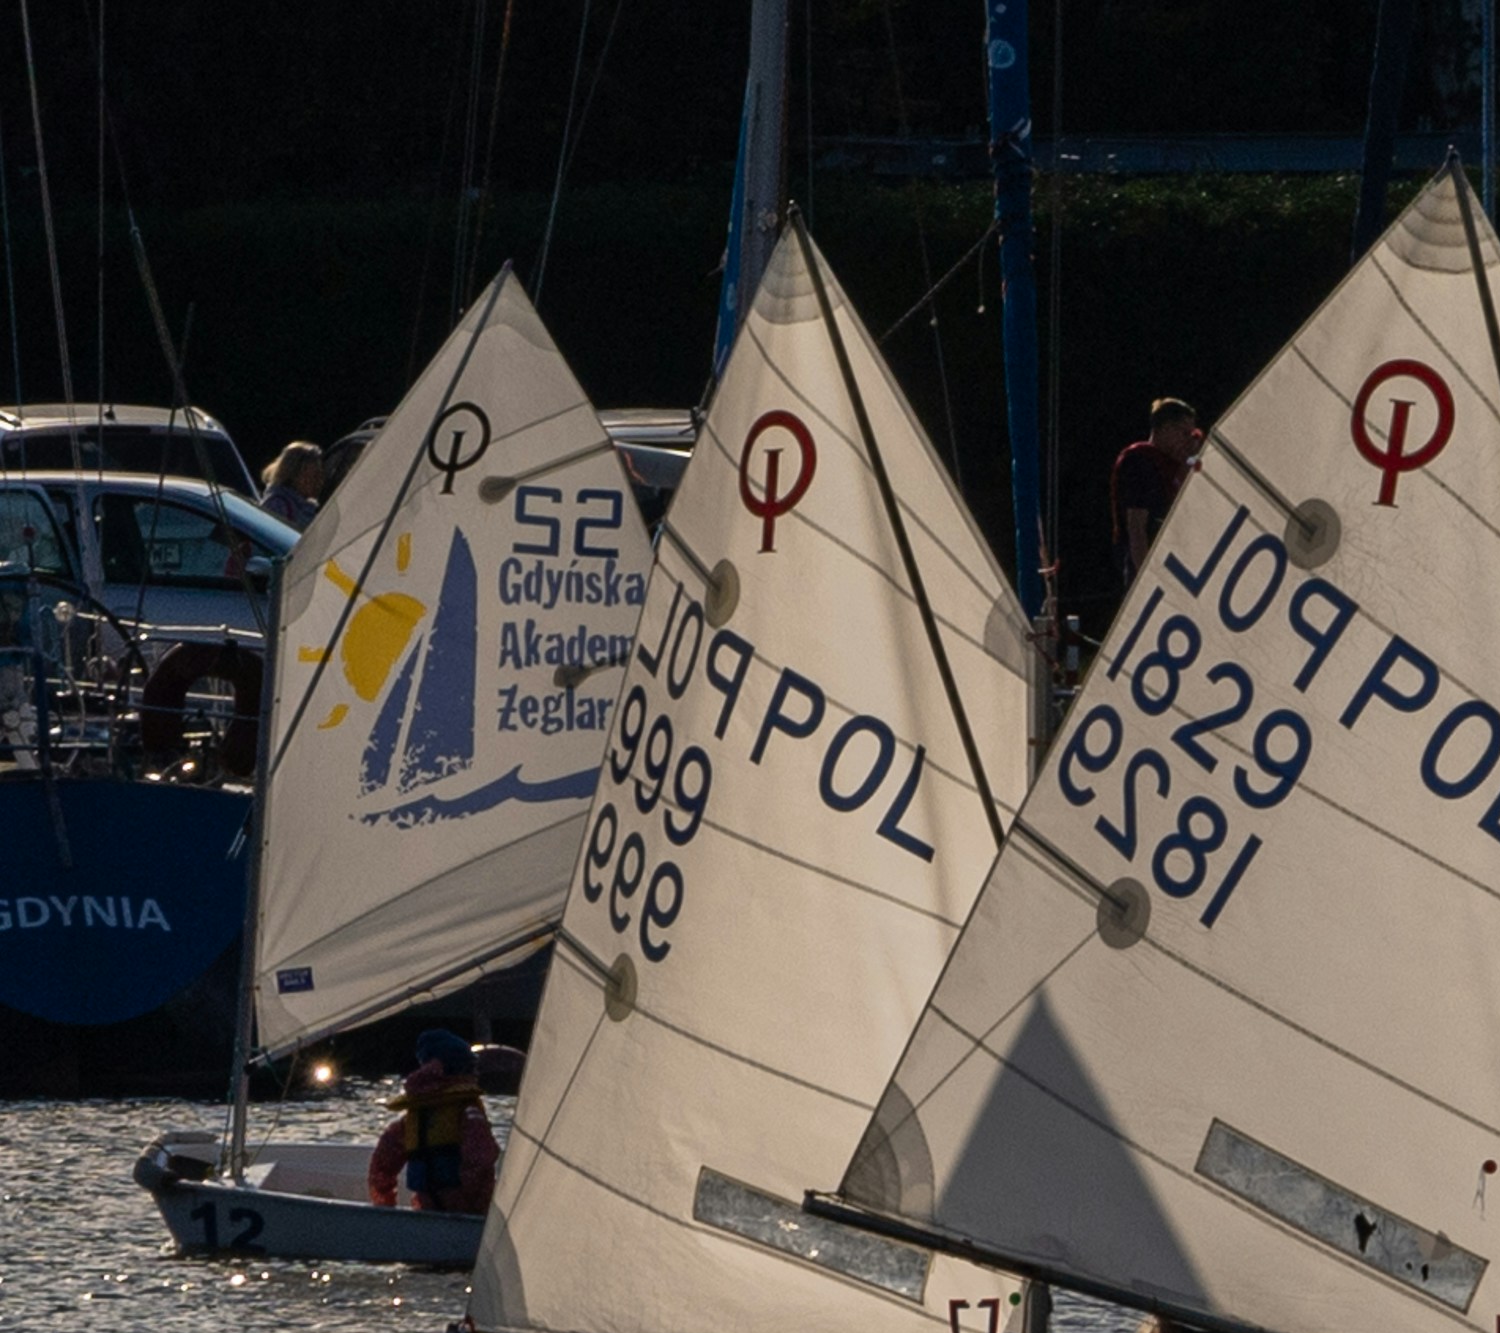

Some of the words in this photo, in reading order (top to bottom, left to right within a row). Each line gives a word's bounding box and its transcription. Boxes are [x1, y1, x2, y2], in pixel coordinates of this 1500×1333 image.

[498, 557, 646, 610] Gdyńska
[610, 685, 712, 846] 999
[749, 666, 935, 864] POL
[1106, 586, 1312, 809] 1829
